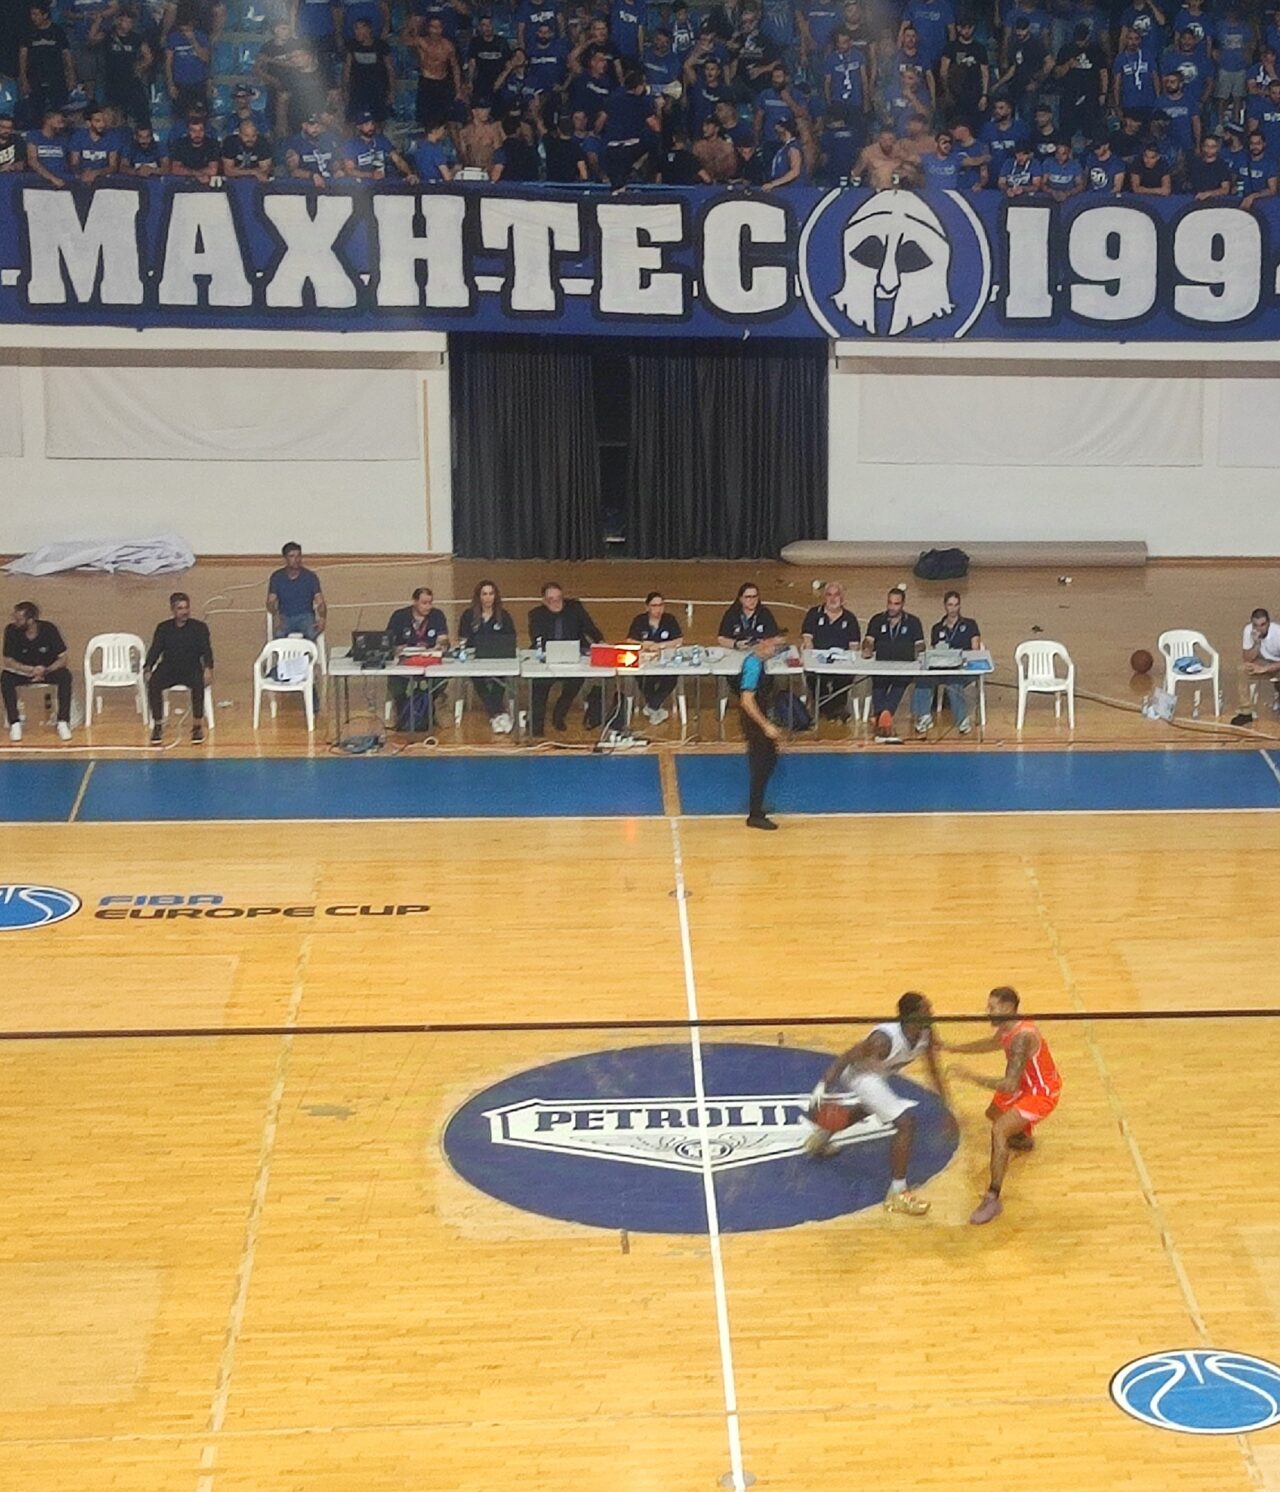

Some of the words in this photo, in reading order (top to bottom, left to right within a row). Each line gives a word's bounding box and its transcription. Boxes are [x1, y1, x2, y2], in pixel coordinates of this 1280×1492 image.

[99, 895, 223, 906] FIBA
[94, 906, 316, 919] EUROPE
[324, 905, 431, 917] CUP
